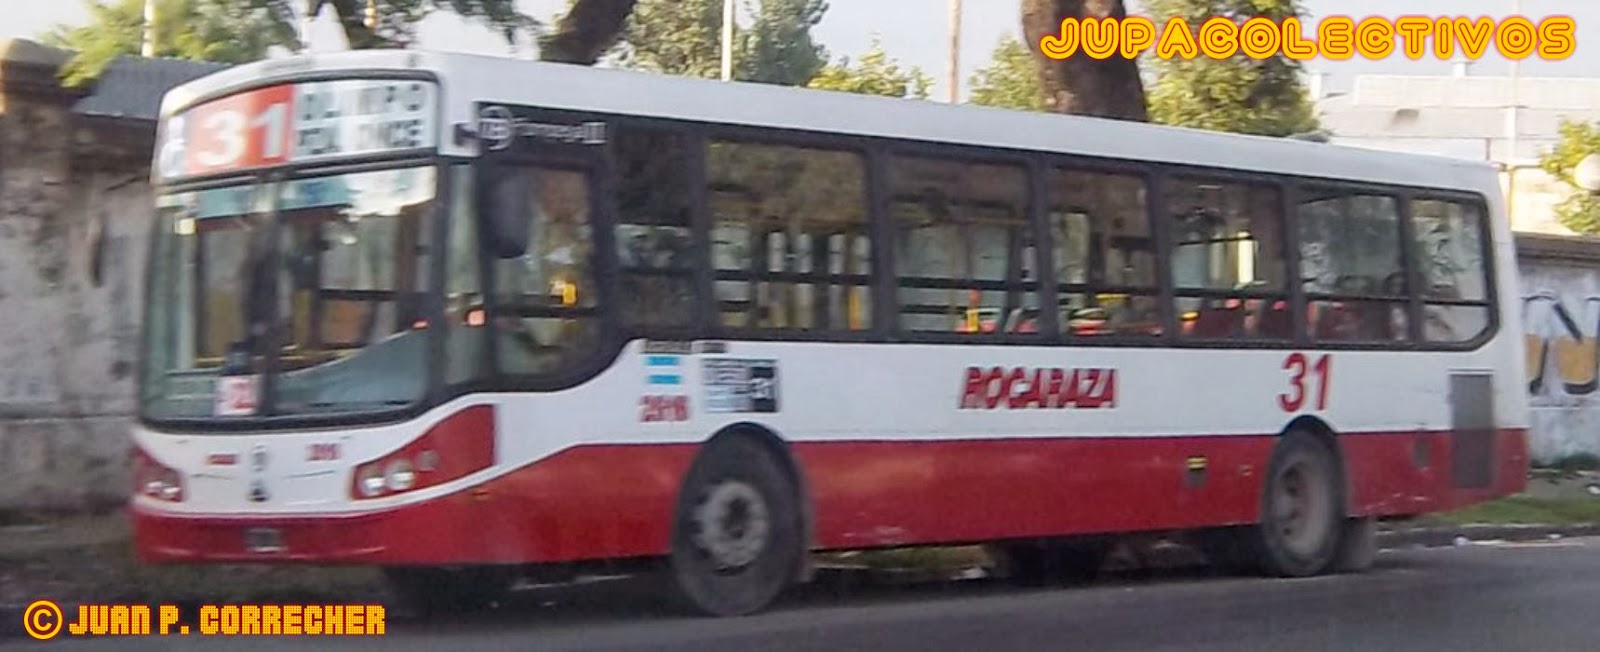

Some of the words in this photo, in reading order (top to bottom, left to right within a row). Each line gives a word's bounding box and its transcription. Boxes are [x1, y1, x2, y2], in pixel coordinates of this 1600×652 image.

[196, 103, 289, 166] 31
[958, 366, 1120, 409] ROCARAZA
[1277, 352, 1331, 412] 31
